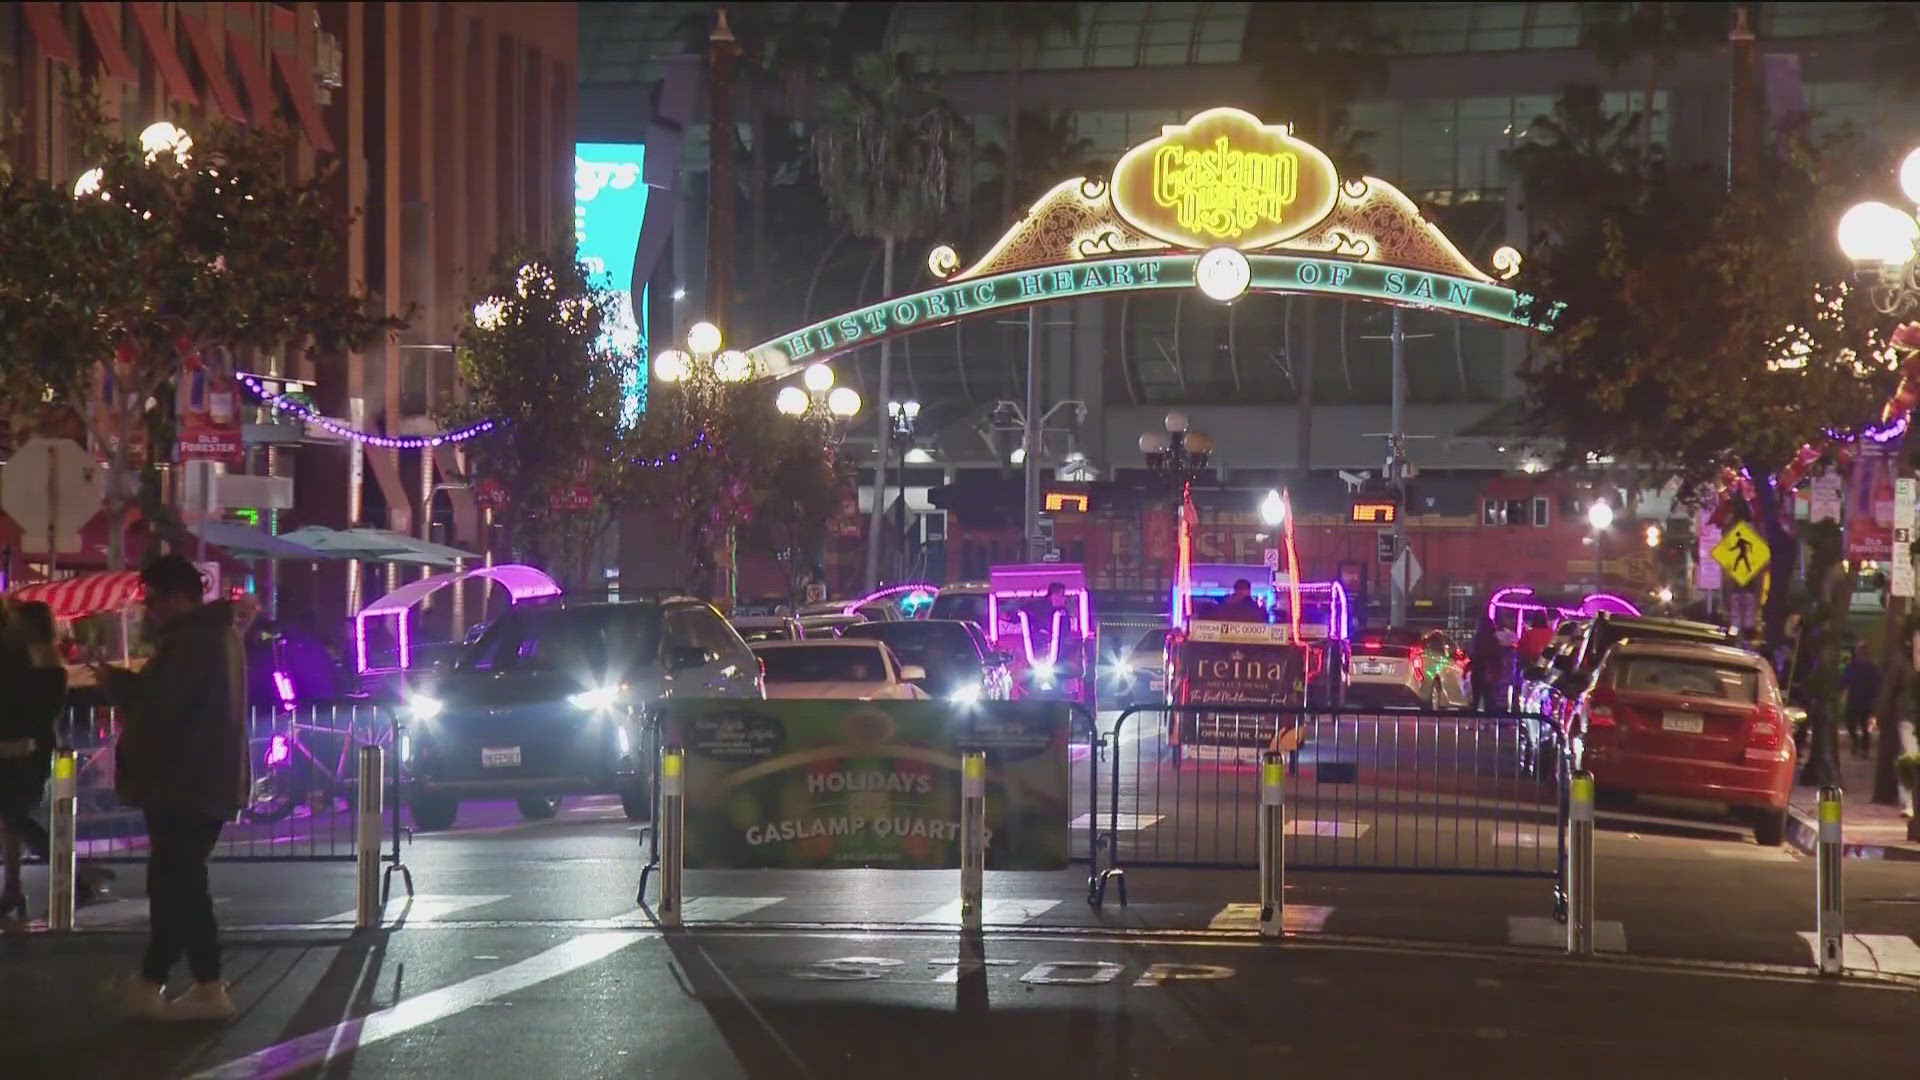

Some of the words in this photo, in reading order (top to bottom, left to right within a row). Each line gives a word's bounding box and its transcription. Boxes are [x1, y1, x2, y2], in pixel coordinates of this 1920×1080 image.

[1154, 136, 1298, 208] Gaslamp
[785, 280, 997, 361] HISTORIC
[1019, 261, 1160, 297] HEART
[1298, 263, 1351, 286] OF
[1385, 273, 1473, 306] SAN
[180, 441, 236, 451] FORESTER
[1197, 658, 1281, 680] reina
[808, 771, 931, 794] HOLIDAYS
[746, 816, 865, 846] GASLAMP
[874, 816, 993, 849] QUARTR
